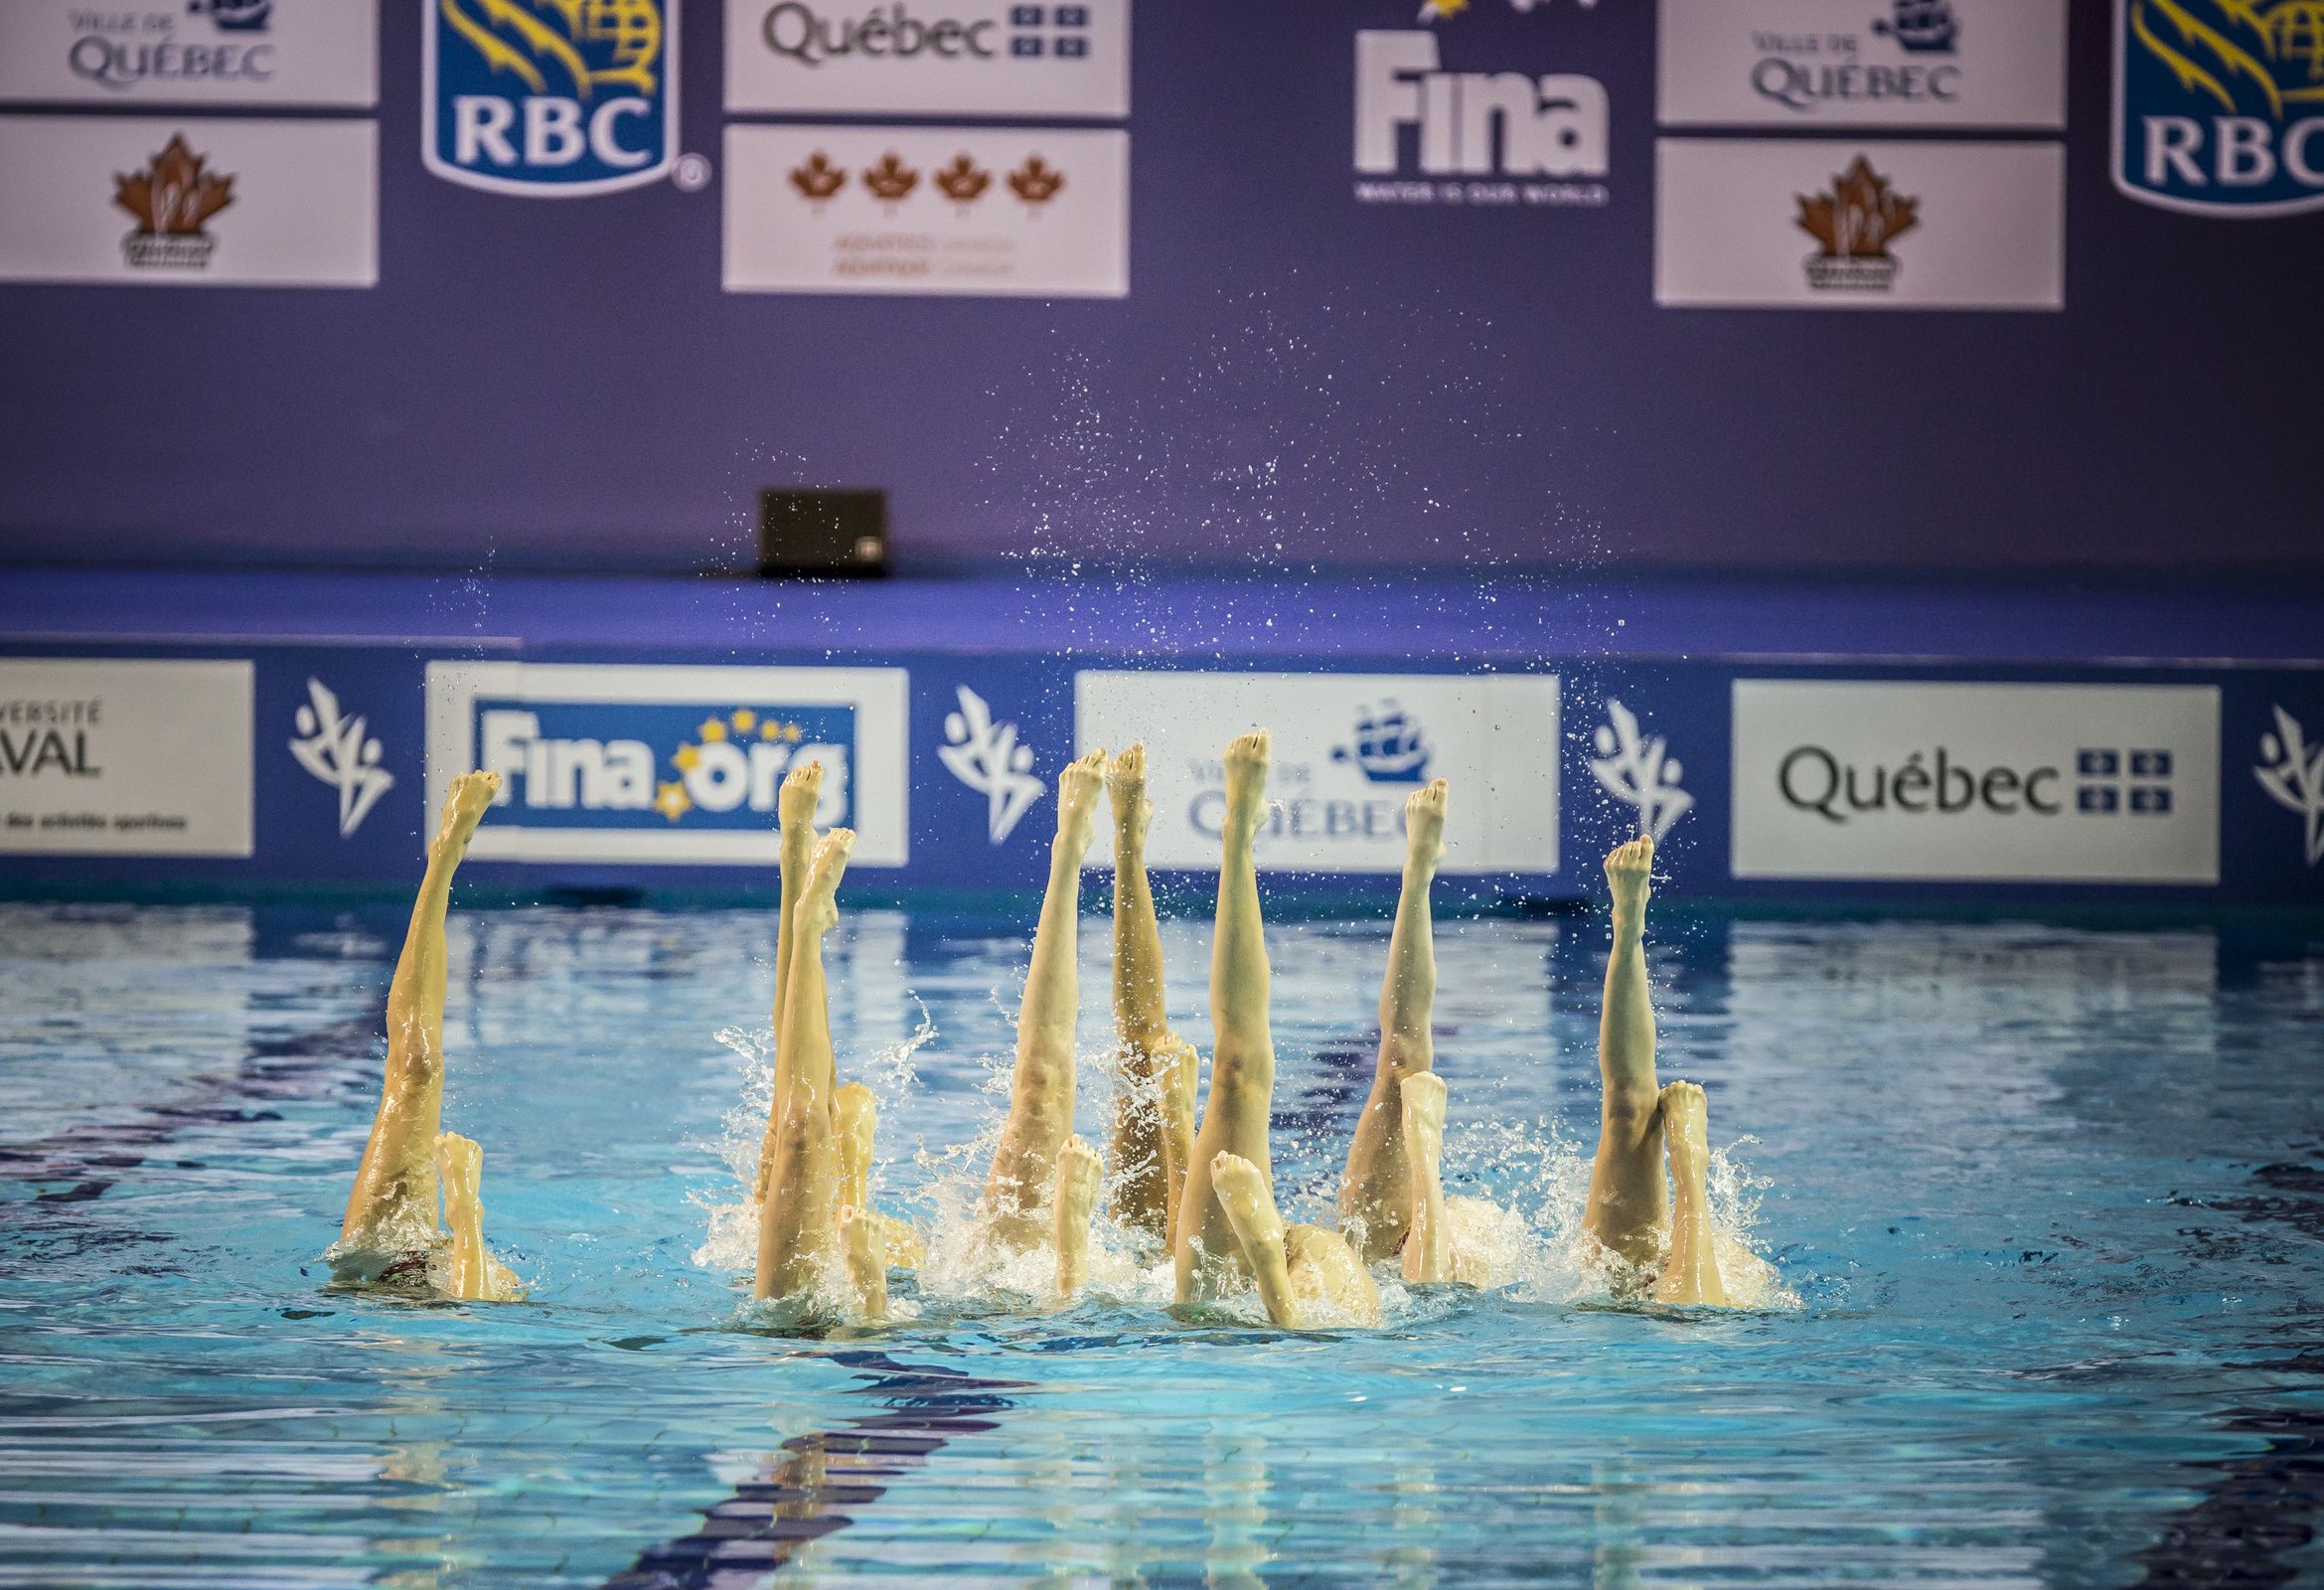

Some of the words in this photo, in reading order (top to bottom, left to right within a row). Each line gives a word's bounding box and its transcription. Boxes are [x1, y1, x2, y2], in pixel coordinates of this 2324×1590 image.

[70, 36, 276, 92] QUÉBEC
[762, 0, 997, 68] Québec
[1354, 30, 1610, 176] Fina
[1751, 57, 1962, 113] QUÉBEC
[454, 96, 652, 167] RBC
[2143, 115, 2324, 186] RBC
[0, 729, 101, 776] VAL
[1778, 745, 2062, 825] Québec
[1188, 790, 1408, 847] QÉBE
